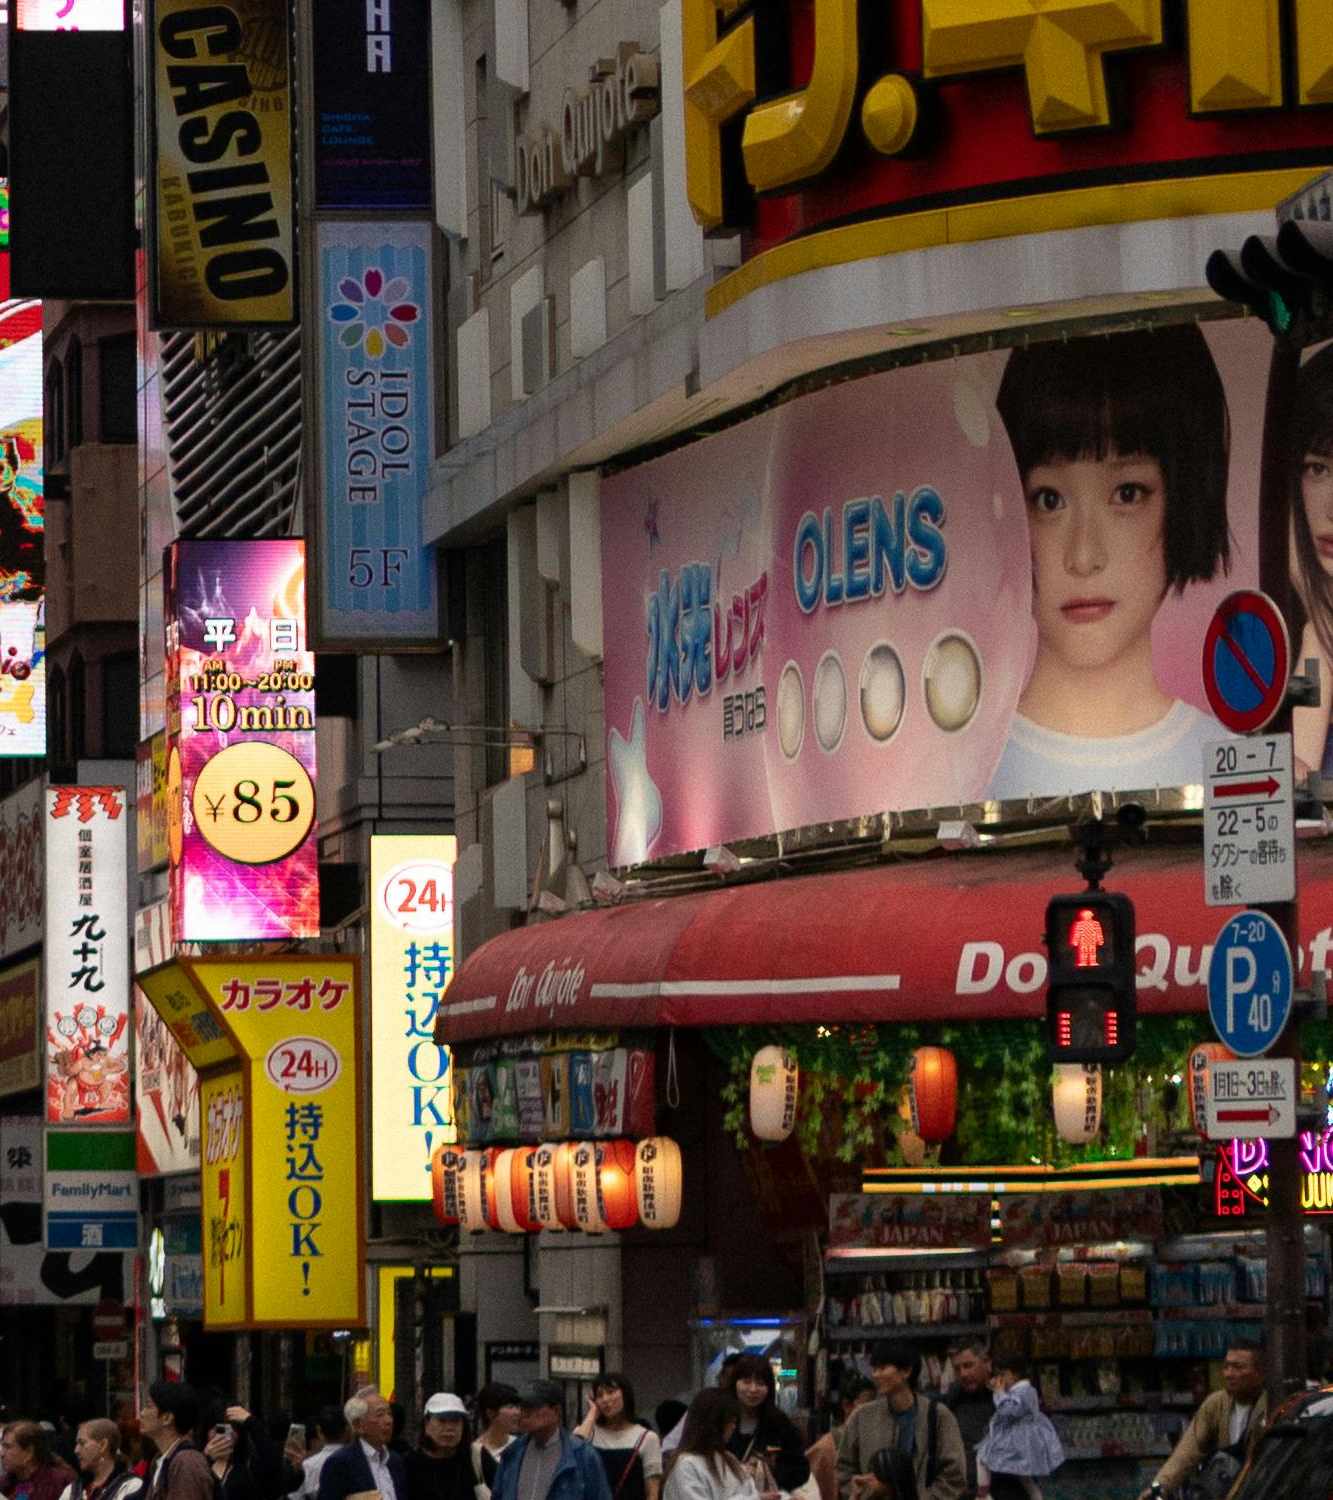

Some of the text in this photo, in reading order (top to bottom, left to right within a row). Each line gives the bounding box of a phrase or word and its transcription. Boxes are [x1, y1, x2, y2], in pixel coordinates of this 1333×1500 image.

[158, 4, 290, 302] CASINO
[346, 369, 378, 502] STAGE
[379, 371, 410, 480] IDOL
[348, 548, 409, 589] 5F
[793, 485, 947, 615] OLENS
[203, 618, 298, 653] 平日
[203, 780, 300, 823] ¥85
[68, 913, 106, 993] 九十九
[1232, 922, 1266, 945] 7-20
[955, 943, 1048, 996] Do
[1225, 945, 1258, 1035] P
[219, 976, 350, 1014] カラオケ
[1247, 995, 1272, 1033] 40
[278, 1046, 331, 1081] 24H
[51, 1181, 132, 1200] FamilyMart
[81, 1222, 104, 1247] 酒
[880, 1225, 944, 1244] JAPAN
